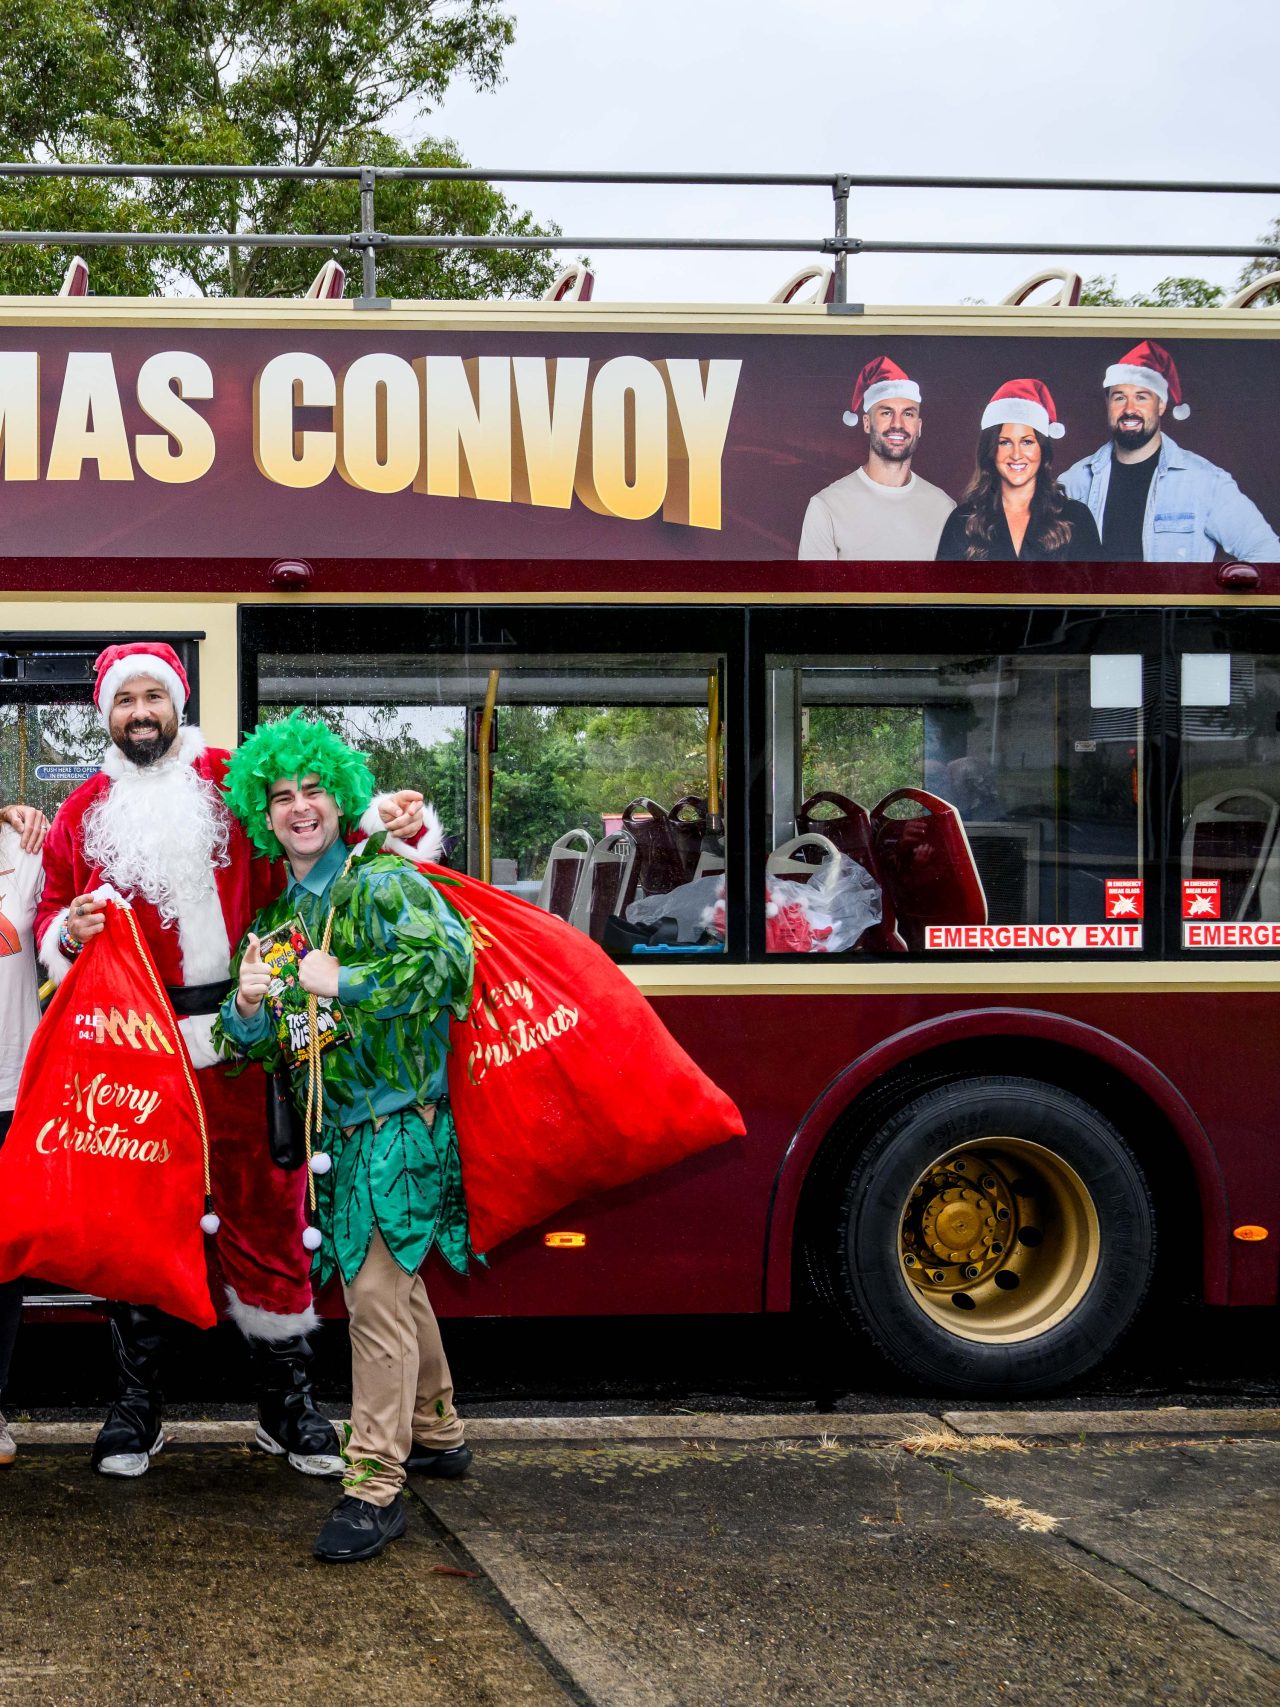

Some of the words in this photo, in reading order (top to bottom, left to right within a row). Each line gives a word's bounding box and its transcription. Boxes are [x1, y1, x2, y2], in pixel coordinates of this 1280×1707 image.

[253, 351, 743, 531] CONVOY
[928, 926, 1077, 948] EMERGENCY
[1085, 926, 1139, 947] EXIT
[62, 1072, 163, 1125] Merry
